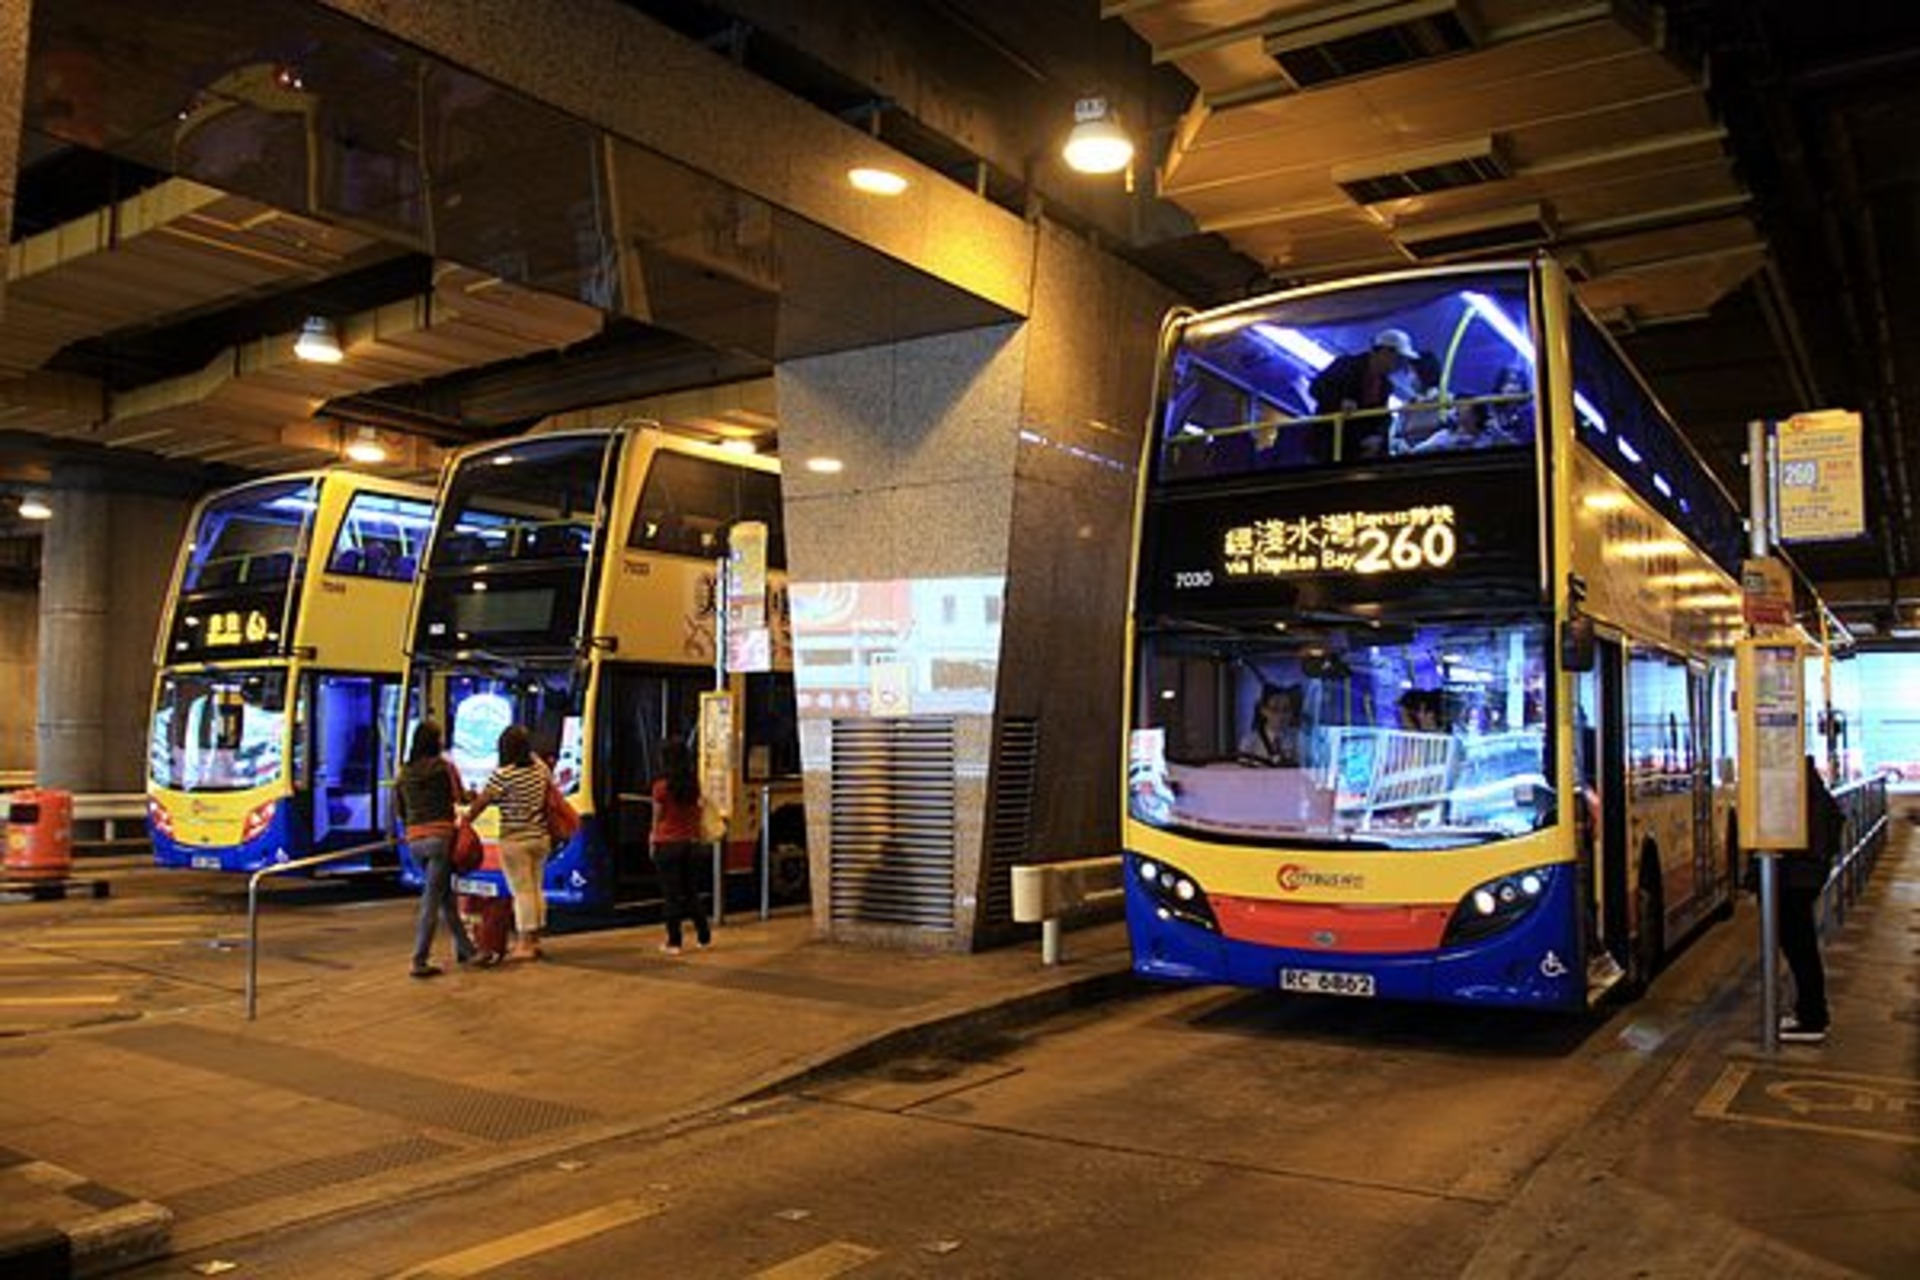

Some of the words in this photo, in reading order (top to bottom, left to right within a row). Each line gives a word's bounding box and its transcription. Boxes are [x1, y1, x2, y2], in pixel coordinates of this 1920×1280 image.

[1784, 462, 1816, 485] 260
[1353, 524, 1456, 574] 260
[1225, 557, 1249, 575] via
[1321, 549, 1357, 571] Bay
[1175, 570, 1214, 589] 7030
[1285, 969, 1310, 987] RC
[1318, 973, 1370, 994] 6862
